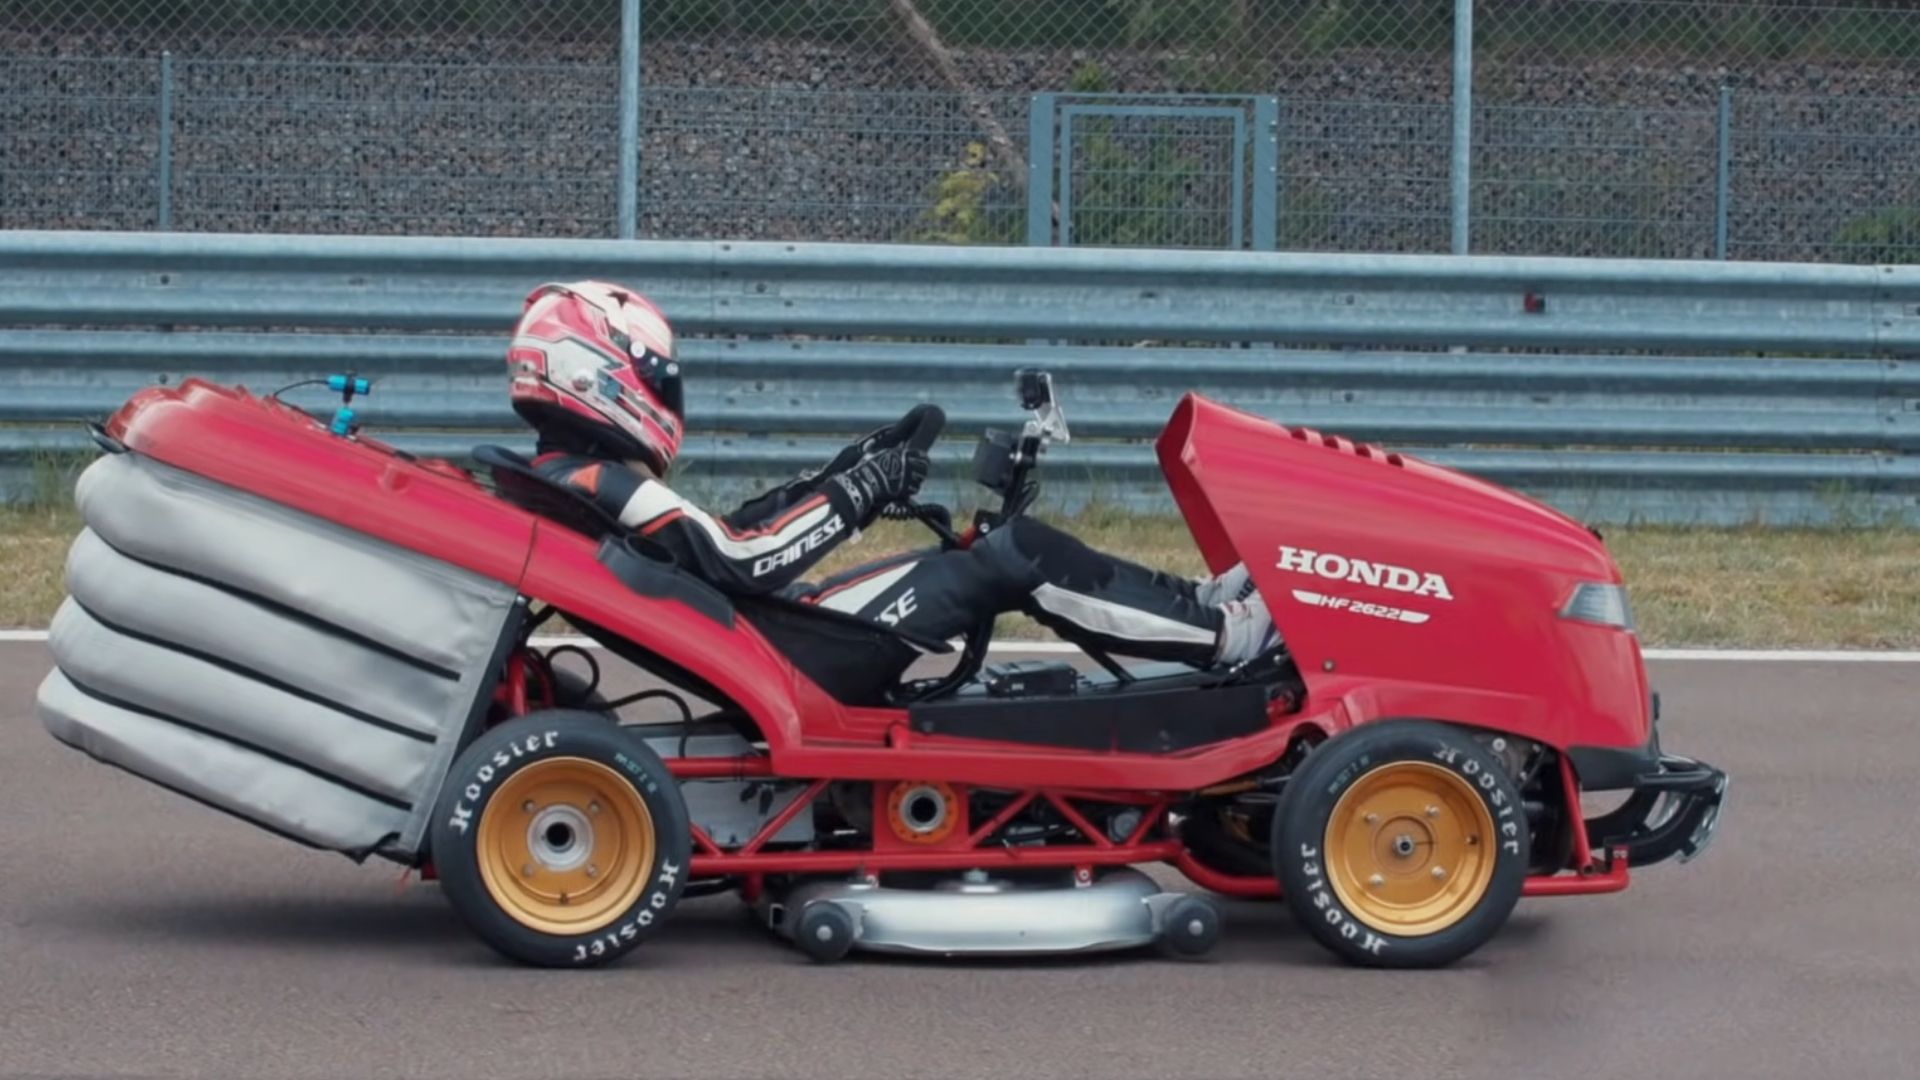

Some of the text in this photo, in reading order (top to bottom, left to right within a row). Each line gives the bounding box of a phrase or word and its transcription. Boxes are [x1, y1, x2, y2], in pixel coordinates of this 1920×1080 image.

[873, 587, 918, 626] SE
[1276, 546, 1453, 600] HONDA
[1319, 595, 1401, 620] HF 2622
[450, 731, 559, 836] Hoosier
[1432, 741, 1519, 855] Hoosier
[573, 855, 679, 962] Hoosier
[1301, 842, 1390, 954] Hoosier
